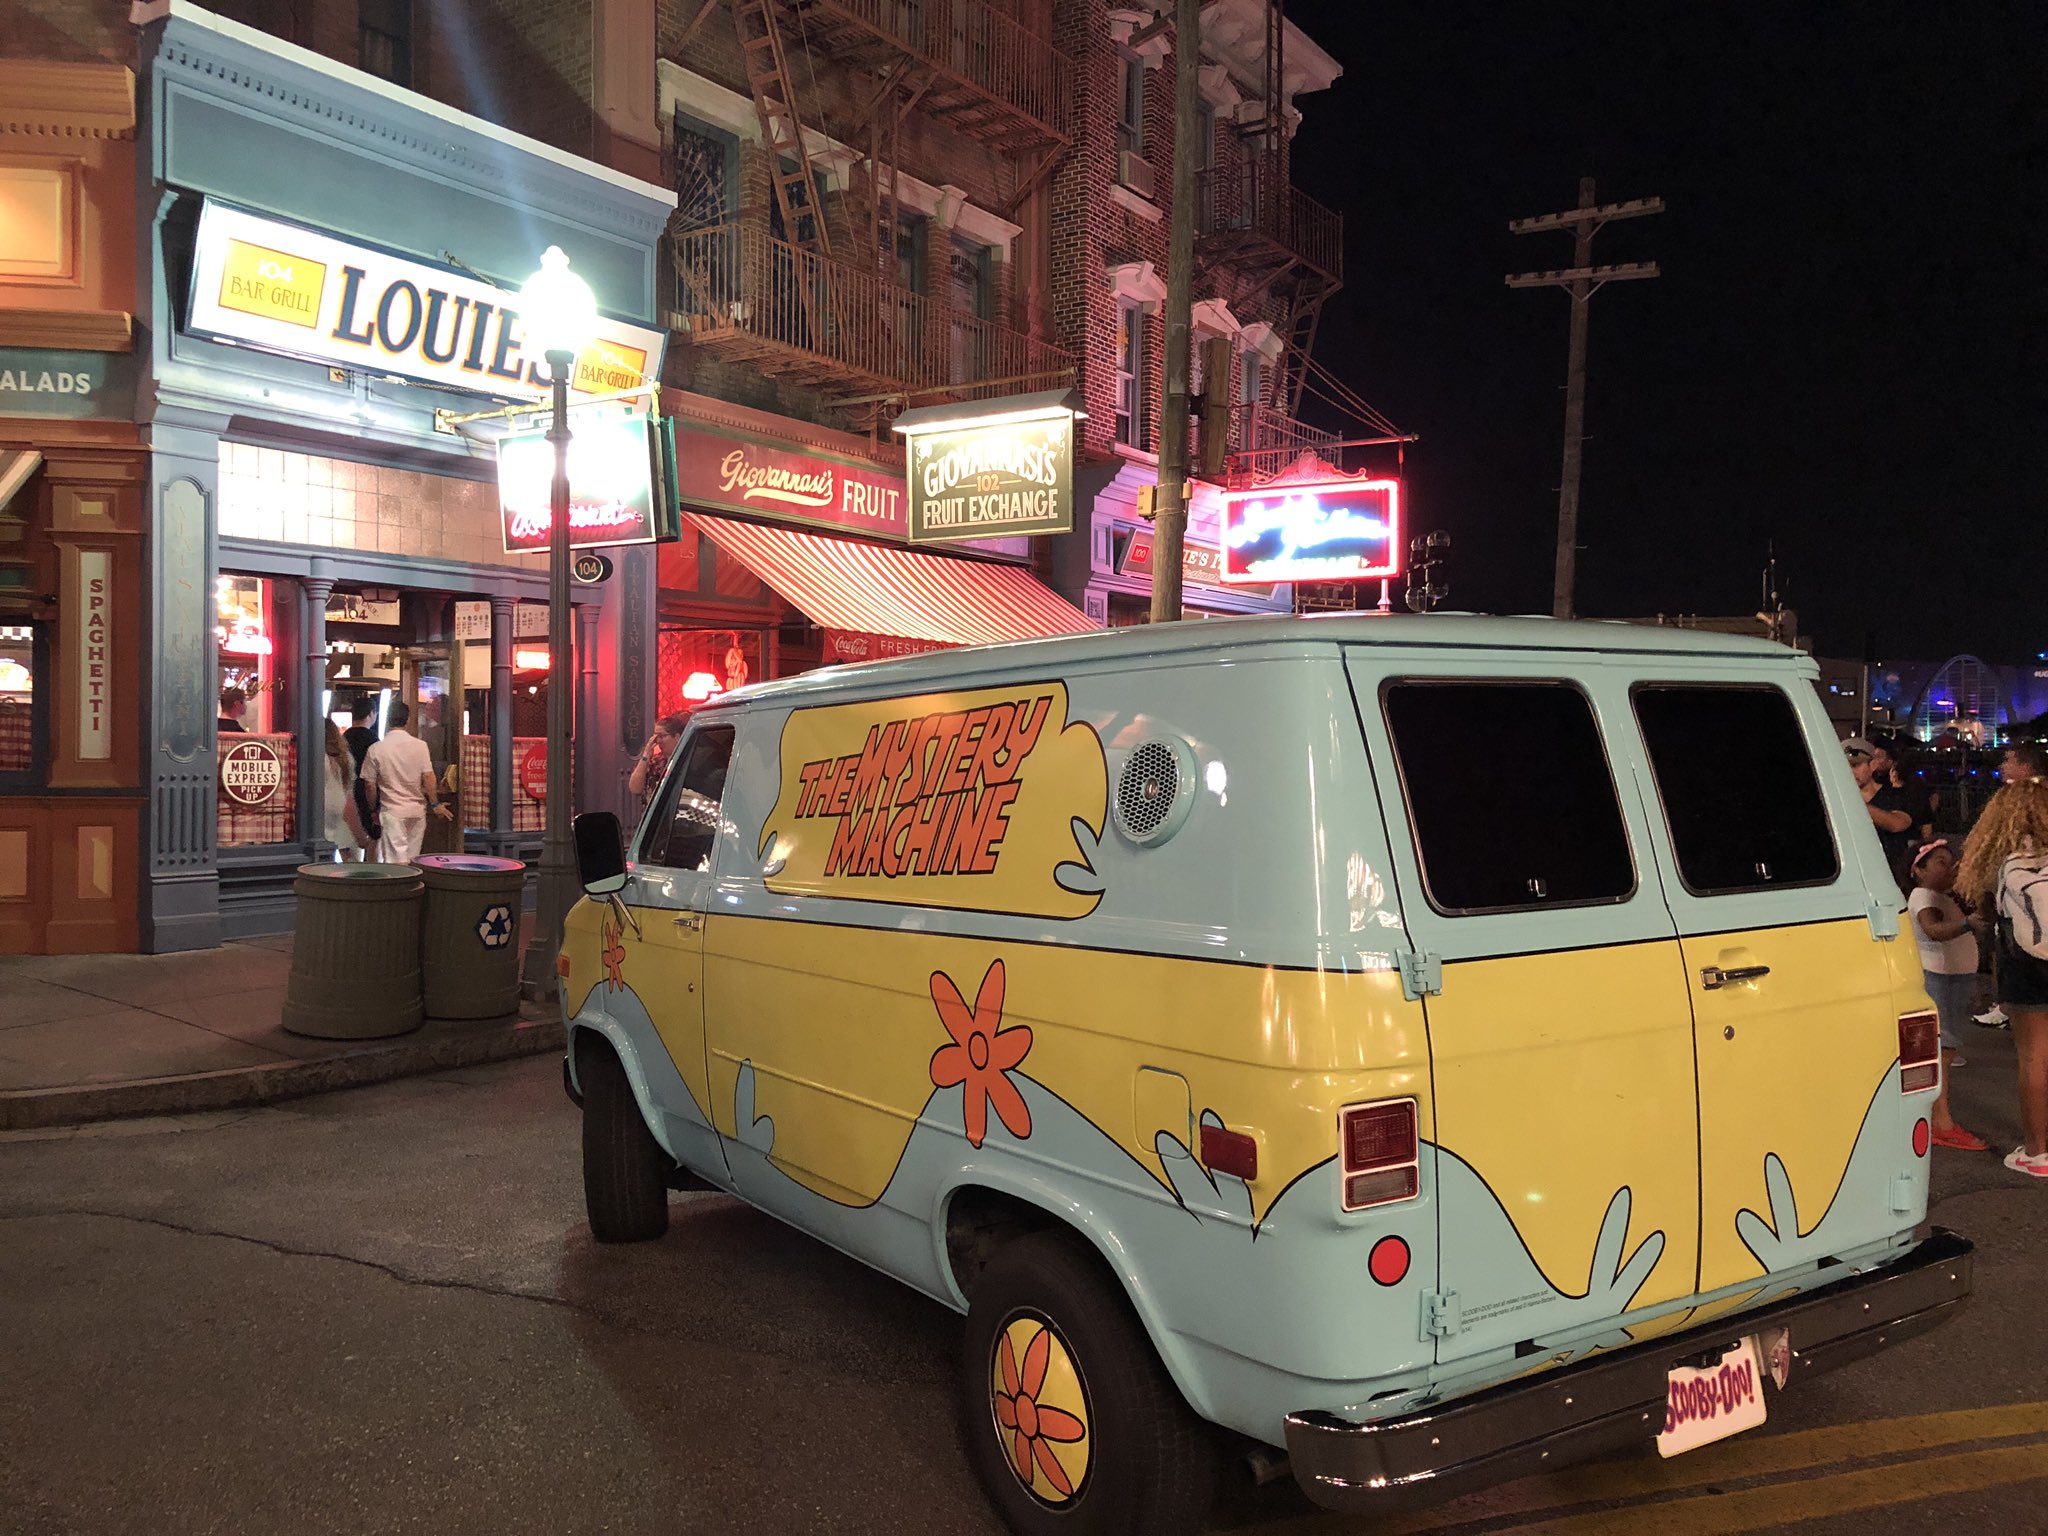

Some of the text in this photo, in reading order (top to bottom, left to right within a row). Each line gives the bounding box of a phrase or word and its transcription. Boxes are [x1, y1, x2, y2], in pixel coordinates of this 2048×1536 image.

[230, 276, 312, 313] BAR GRILL
[332, 264, 553, 389] LOUIE
[580, 364, 604, 384] BAR
[977, 474, 1000, 492] 102
[842, 479, 900, 521] FRUIT
[923, 488, 1059, 530] FRUIT EXCHANGE
[1134, 548, 1147, 559] 100
[579, 562, 598, 576] 104
[88, 579, 105, 731] SPAGHETTI
[880, 640, 919, 654] FRESH
[794, 695, 1054, 819] THE MYSTERY
[231, 762, 273, 772] MOBILE
[227, 773, 277, 783] EXPRESS
[241, 785, 262, 794] PICK
[246, 793, 259, 801] UP
[824, 778, 1023, 878] MACHINE
